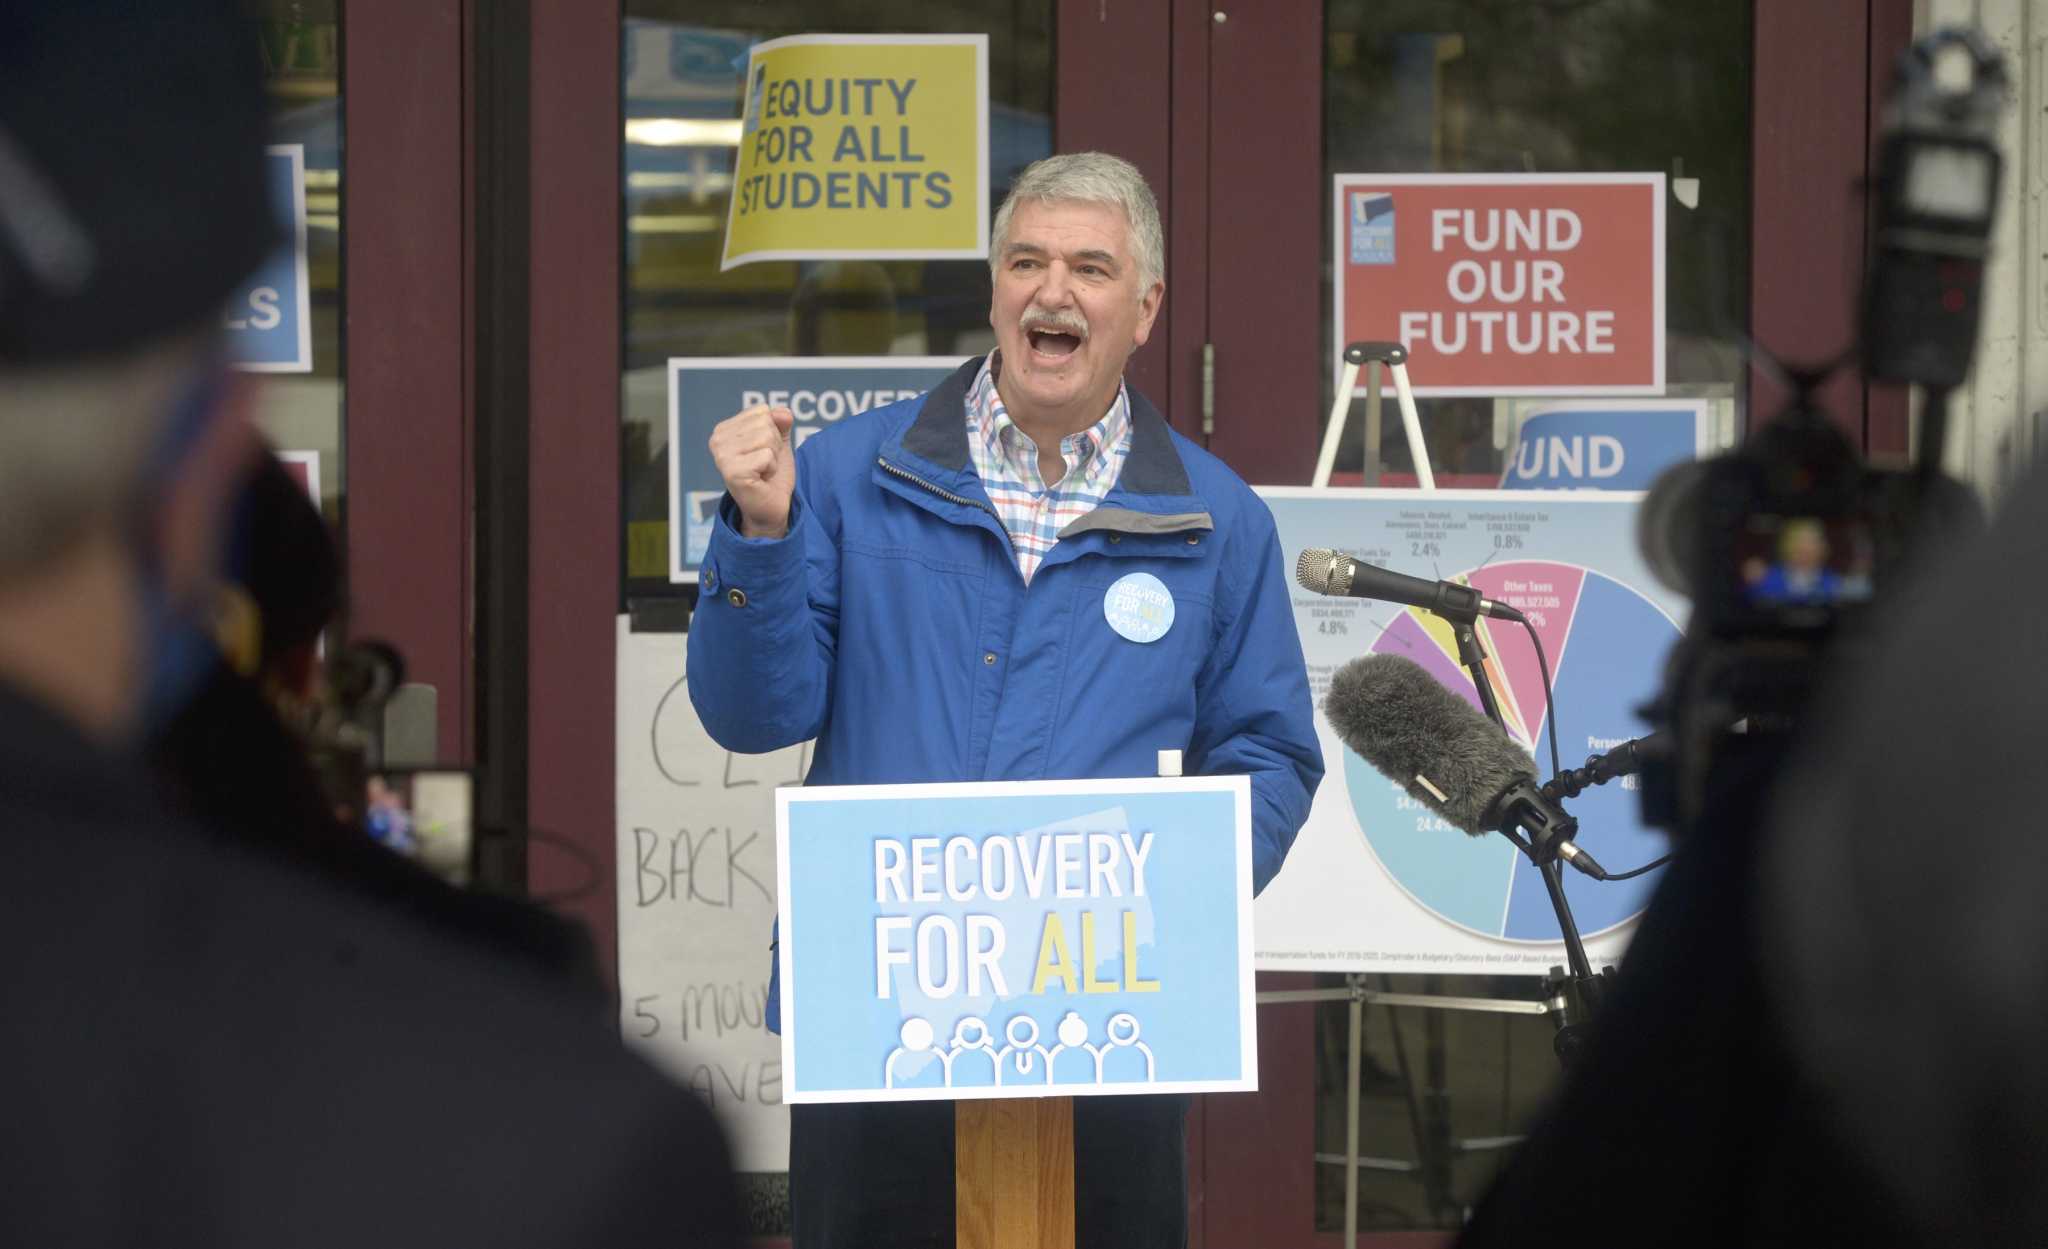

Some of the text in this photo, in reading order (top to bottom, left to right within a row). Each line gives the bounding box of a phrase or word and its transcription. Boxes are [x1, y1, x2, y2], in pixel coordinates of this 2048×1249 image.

[766, 78, 917, 119] EQUITY
[755, 125, 926, 168] FOR ALL
[739, 171, 953, 216] STUDENTS
[1431, 208, 1583, 252] FUND
[1446, 259, 1566, 304] OUR
[1400, 310, 1616, 355] FUTURE
[1411, 542, 1440, 558] 2.4%
[1493, 534, 1523, 550] 0.8%
[1503, 580, 1527, 593] Other
[1318, 620, 1347, 636] 4.8%
[633, 826, 773, 908] BACK
[875, 832, 1156, 904] RECOVERY
[875, 910, 1162, 1000] FOR ALL
[635, 994, 660, 1038] 5
[689, 1063, 781, 1108] AVE
